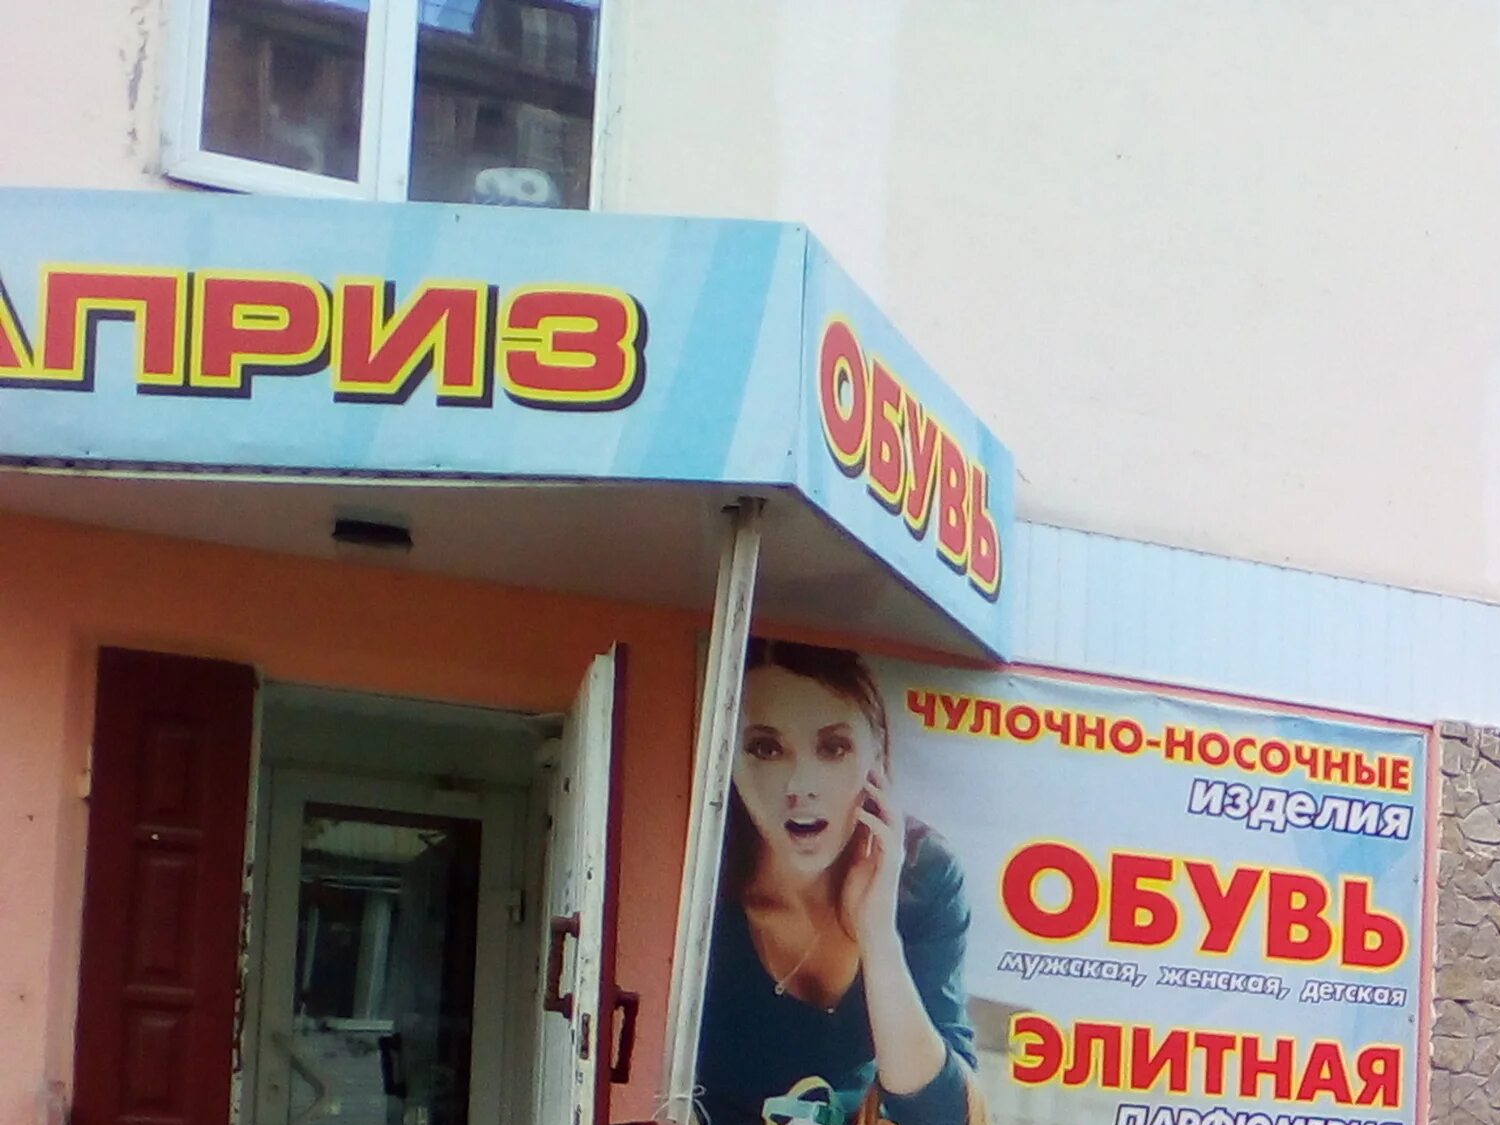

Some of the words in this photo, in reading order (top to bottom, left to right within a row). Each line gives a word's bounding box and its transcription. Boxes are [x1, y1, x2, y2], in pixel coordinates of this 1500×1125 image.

[817, 314, 1002, 604] ОБУВЬ
[905, 688, 1413, 792] ЧУЛОЧНО-НОСОЧНЫЕ
[1001, 841, 1405, 968] ОБУВЬ
[998, 951, 1147, 987] мужская,
[1157, 965, 1290, 999] женская,
[1300, 978, 1407, 1007] детская
[1010, 1013, 1403, 1108] ЭЛИТНАЯ
